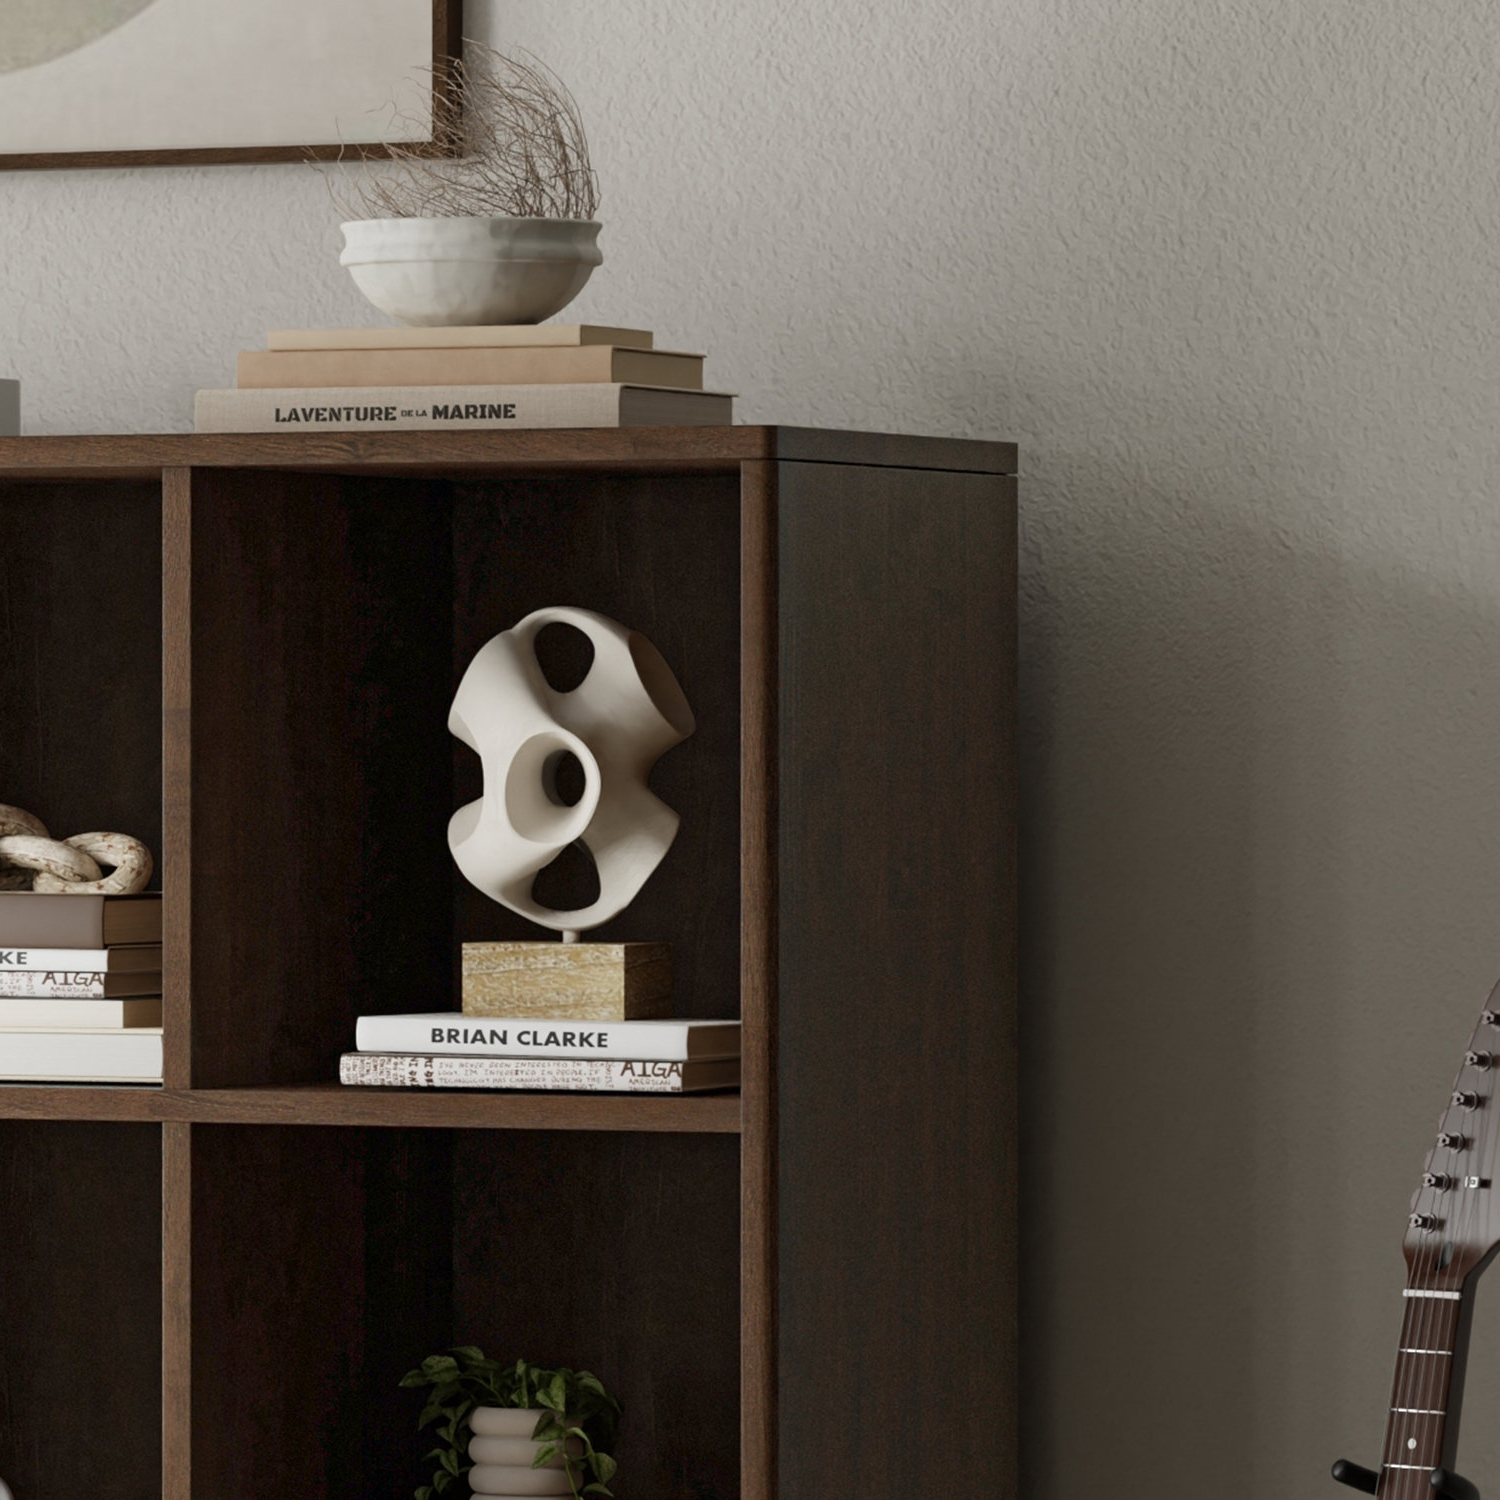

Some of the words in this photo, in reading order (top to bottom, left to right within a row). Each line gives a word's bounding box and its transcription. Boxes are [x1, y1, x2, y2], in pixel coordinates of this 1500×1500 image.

[275, 405, 397, 423] LAVENTURE
[401, 409, 413, 417] DE
[415, 409, 427, 417] LA
[433, 403, 516, 421] MARINE
[42, 972, 105, 987] AIGA
[431, 1028, 508, 1046] BRIAN
[517, 1030, 609, 1049] CLARKE
[620, 1060, 682, 1079] AIGA
